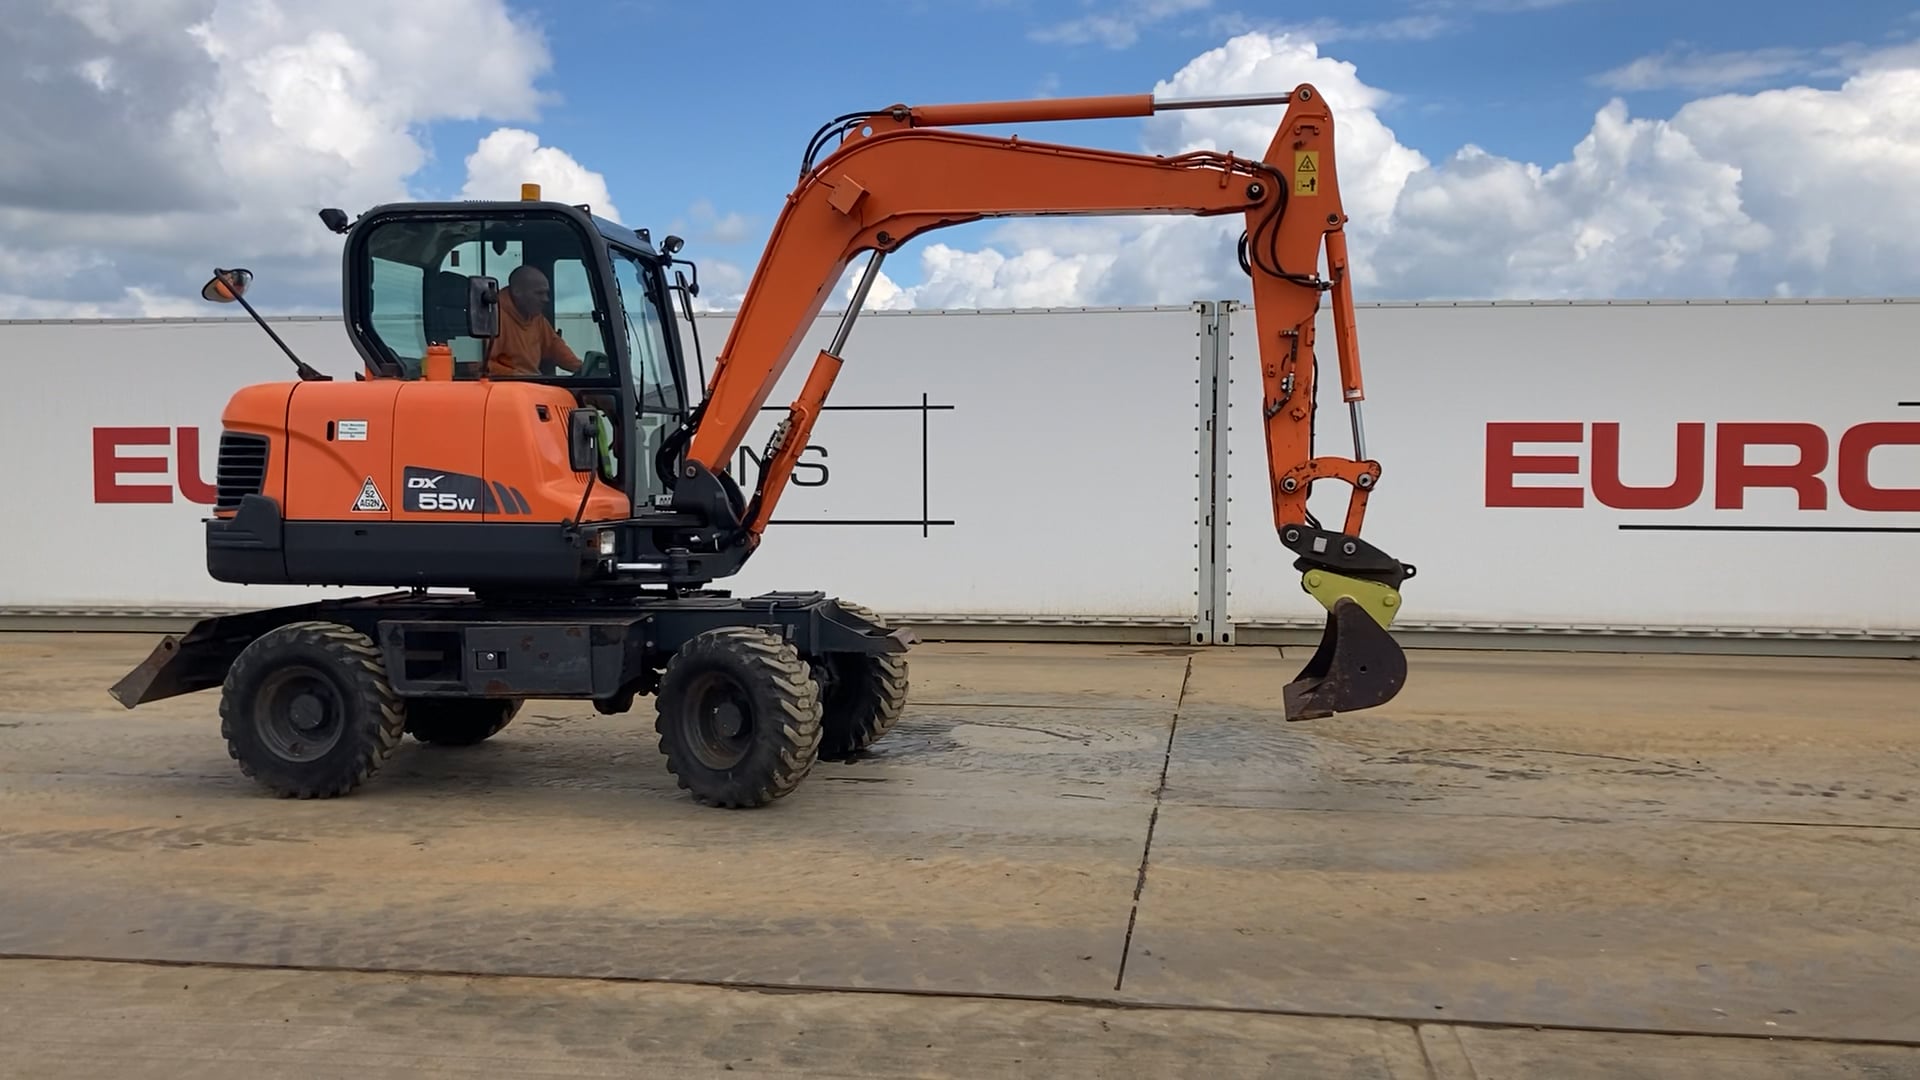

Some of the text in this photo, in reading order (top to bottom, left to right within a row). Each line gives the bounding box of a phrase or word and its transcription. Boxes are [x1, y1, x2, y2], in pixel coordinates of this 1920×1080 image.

[1485, 422, 1920, 512] EURO
[407, 475, 445, 489] DX
[365, 490, 375, 498] 52
